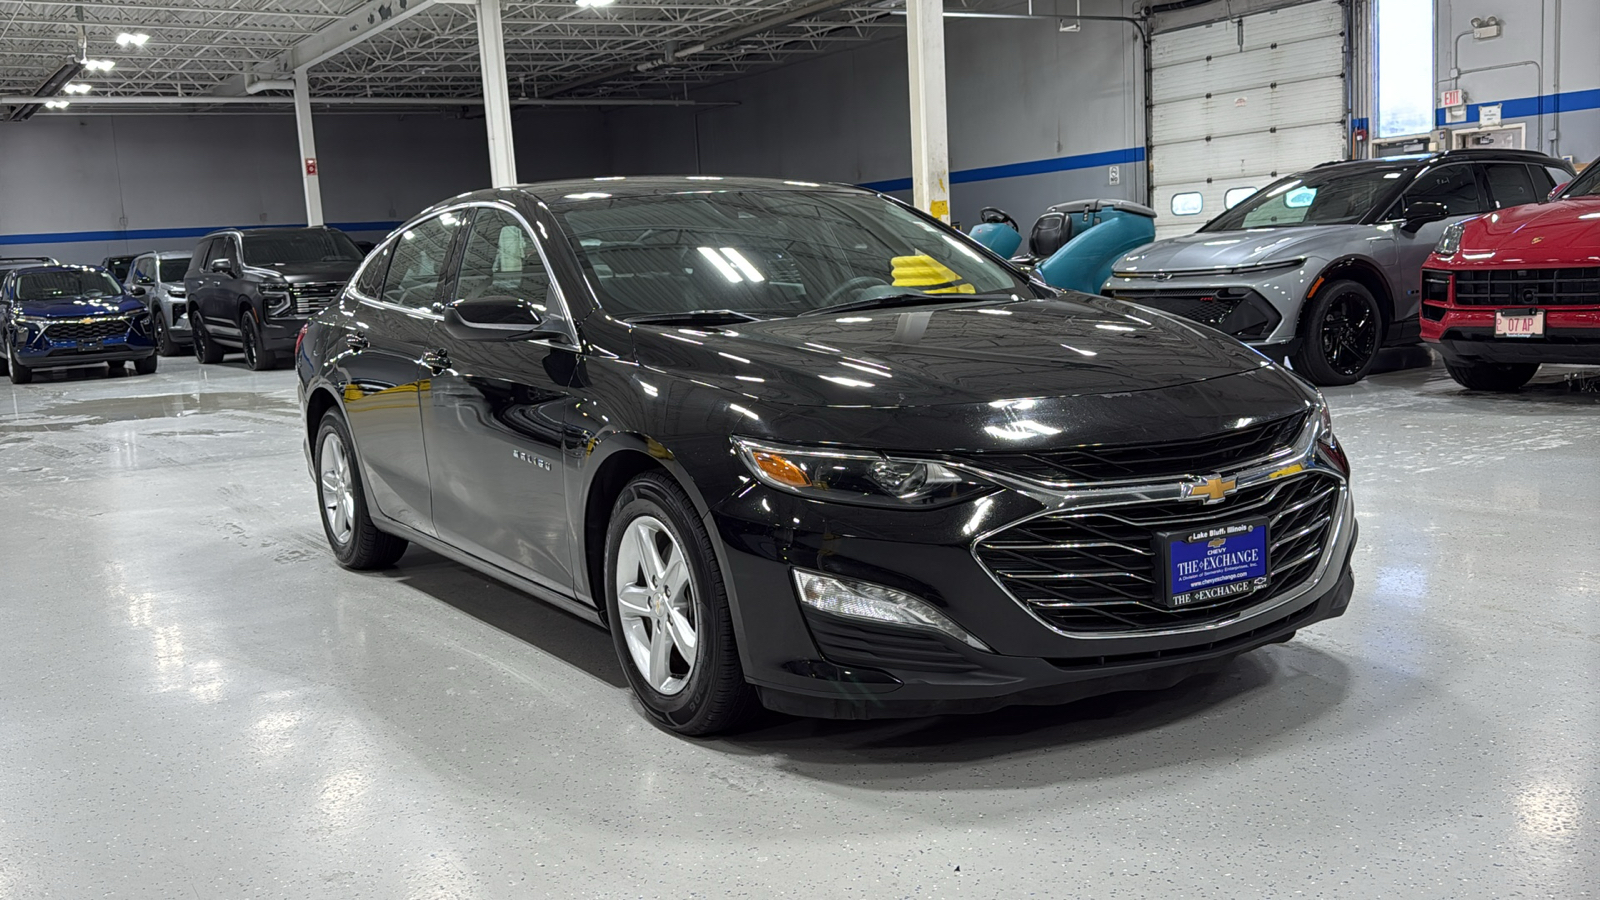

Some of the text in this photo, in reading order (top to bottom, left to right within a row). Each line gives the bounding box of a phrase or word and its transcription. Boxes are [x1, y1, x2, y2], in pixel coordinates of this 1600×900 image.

[1444, 90, 1459, 105] EXIT
[1508, 317, 1534, 332] 07 AP
[1193, 531, 1208, 540] Lake
[1227, 524, 1247, 534] Illinois
[1207, 547, 1227, 556] CHEVY
[1177, 548, 1259, 576] THE EXCHANGE
[1190, 571, 1248, 588] www.chevyexchange.com
[1173, 581, 1249, 605] THE EXCHANGE
